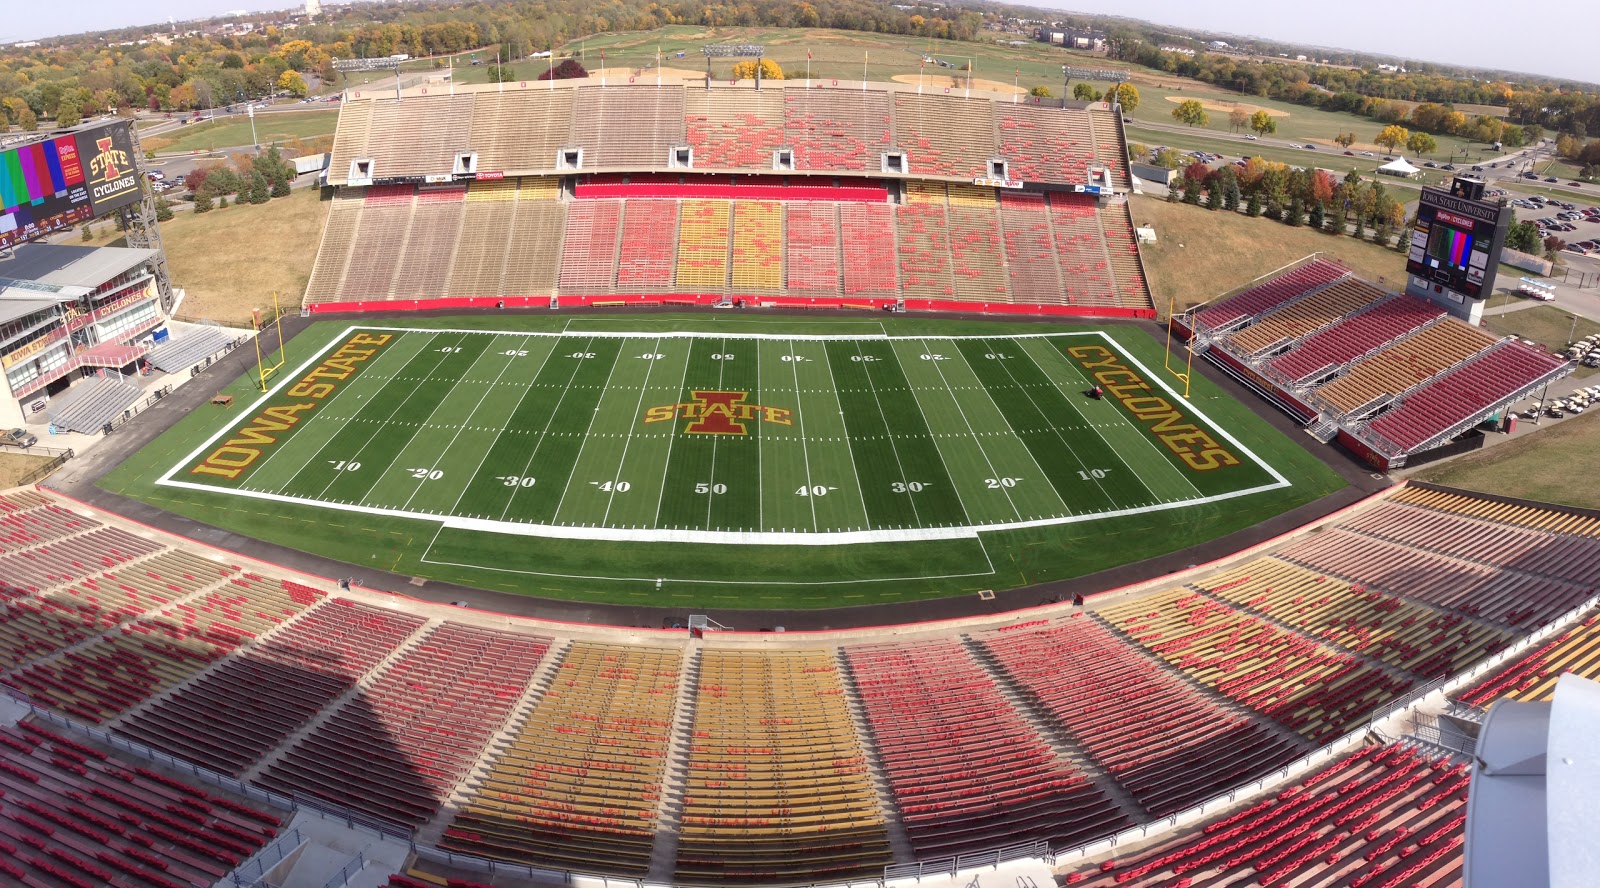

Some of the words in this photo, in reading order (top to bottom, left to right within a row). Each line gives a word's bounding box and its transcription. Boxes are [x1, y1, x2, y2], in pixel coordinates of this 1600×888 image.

[90, 150, 128, 176] STATE
[93, 176, 135, 198] CYCLONES
[1439, 196, 1457, 210] STATE
[1457, 201, 1497, 220] UNIVERSITY
[100, 292, 142, 316] CYCLONES
[11, 346, 31, 362] IOWA
[188, 401, 317, 480] IOWA
[286, 332, 395, 400] STATE
[1067, 345, 1242, 471] CYCLONES
[644, 403, 794, 426] STATE
[333, 460, 361, 472] 10
[412, 468, 444, 480] 20
[1076, 468, 1107, 481] 10
[504, 475, 536, 488] 30
[598, 480, 631, 492] 40
[891, 481, 923, 493] 30
[984, 477, 1016, 489] 20
[694, 483, 727, 494] 50
[795, 485, 827, 496] 40
